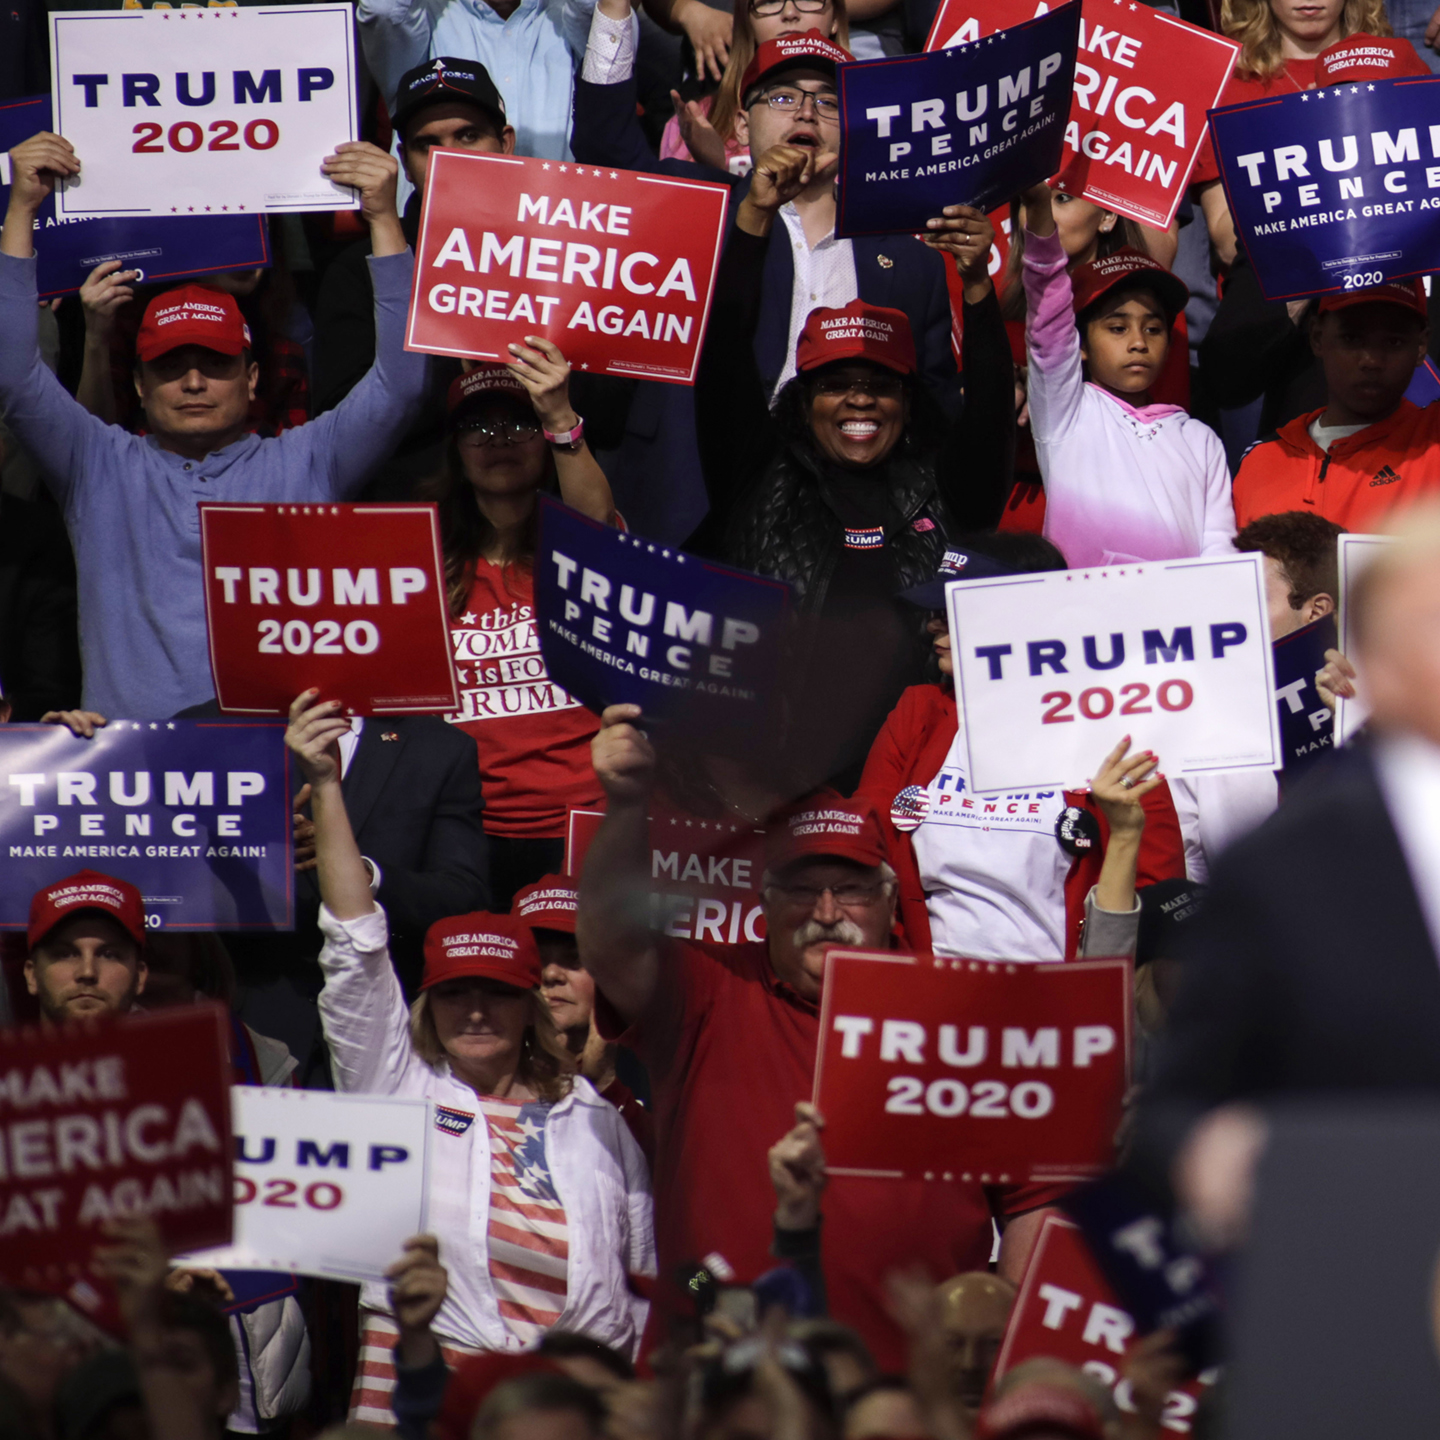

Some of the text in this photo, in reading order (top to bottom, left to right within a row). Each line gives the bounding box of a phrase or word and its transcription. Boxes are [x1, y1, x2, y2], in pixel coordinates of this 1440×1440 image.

[776, 38, 806, 48] MAKE
[781, 46, 815, 55] GREAT
[1323, 47, 1395, 66] MAKE AMERICA
[1328, 58, 1389, 74] GREAT AGAIN
[73, 67, 334, 107] TRUMP
[866, 51, 1063, 138] TRUMP
[132, 119, 279, 153] 2020
[889, 95, 1044, 163] PENCE
[865, 112, 1055, 182] MAKE AMERICA GREAT AGAIN!
[1064, 120, 1178, 189] AGAIN
[517, 193, 632, 236] MAKE
[1254, 221, 1287, 236] MAKE
[1290, 208, 1357, 230] AMERICA
[1362, 200, 1414, 218] GREAT
[432, 227, 697, 302] AMERICA
[1092, 255, 1122, 270] MAKE
[1101, 263, 1134, 275] GREAT
[1343, 271, 1383, 289] 2020
[155, 302, 226, 318] MAKE AMERICA
[157, 312, 223, 326] GREAT AGAIN
[428, 284, 693, 344] GREAT AGAIN
[820, 317, 893, 332] MAKE AMERICA
[825, 329, 889, 342] GREAT AGAIN
[460, 370, 484, 389] MAKE
[464, 380, 492, 396] GREAT
[1369, 474, 1402, 487] adidas
[214, 566, 427, 606] TRUMP
[552, 550, 760, 651] TRUMP
[480, 602, 531, 630] this
[257, 619, 380, 655] 2020
[564, 599, 733, 678] PENCE
[550, 620, 692, 689] MAKE AMERICA GREAT
[974, 622, 1247, 681] TRUMP
[475, 658, 544, 685] is FO
[1040, 679, 1194, 725] 2020
[8, 771, 266, 806] TRUMP
[816, 810, 864, 824] AMERICA
[933, 809, 953, 817] MAKE
[1015, 816, 1041, 824] AGAIN!
[939, 795, 1040, 814] PENCE
[33, 814, 243, 836] PENCE
[793, 823, 859, 836] GREAT AGAIN
[9, 846, 266, 857] MAKE AMERICA GREAT AGAIN!
[651, 849, 752, 889] MAKE
[1160, 892, 1190, 914] MAKE
[442, 933, 518, 949] MAKE AMERICA
[446, 945, 513, 959] GREAT AGAIN
[833, 1014, 1116, 1068] TRUMP
[884, 1075, 1055, 1120] 2020
[436, 1115, 468, 1130] UMP
[10, 1098, 221, 1179] ERICA
[234, 1137, 410, 1172] UMP
[77, 1169, 224, 1225] AGAIN
